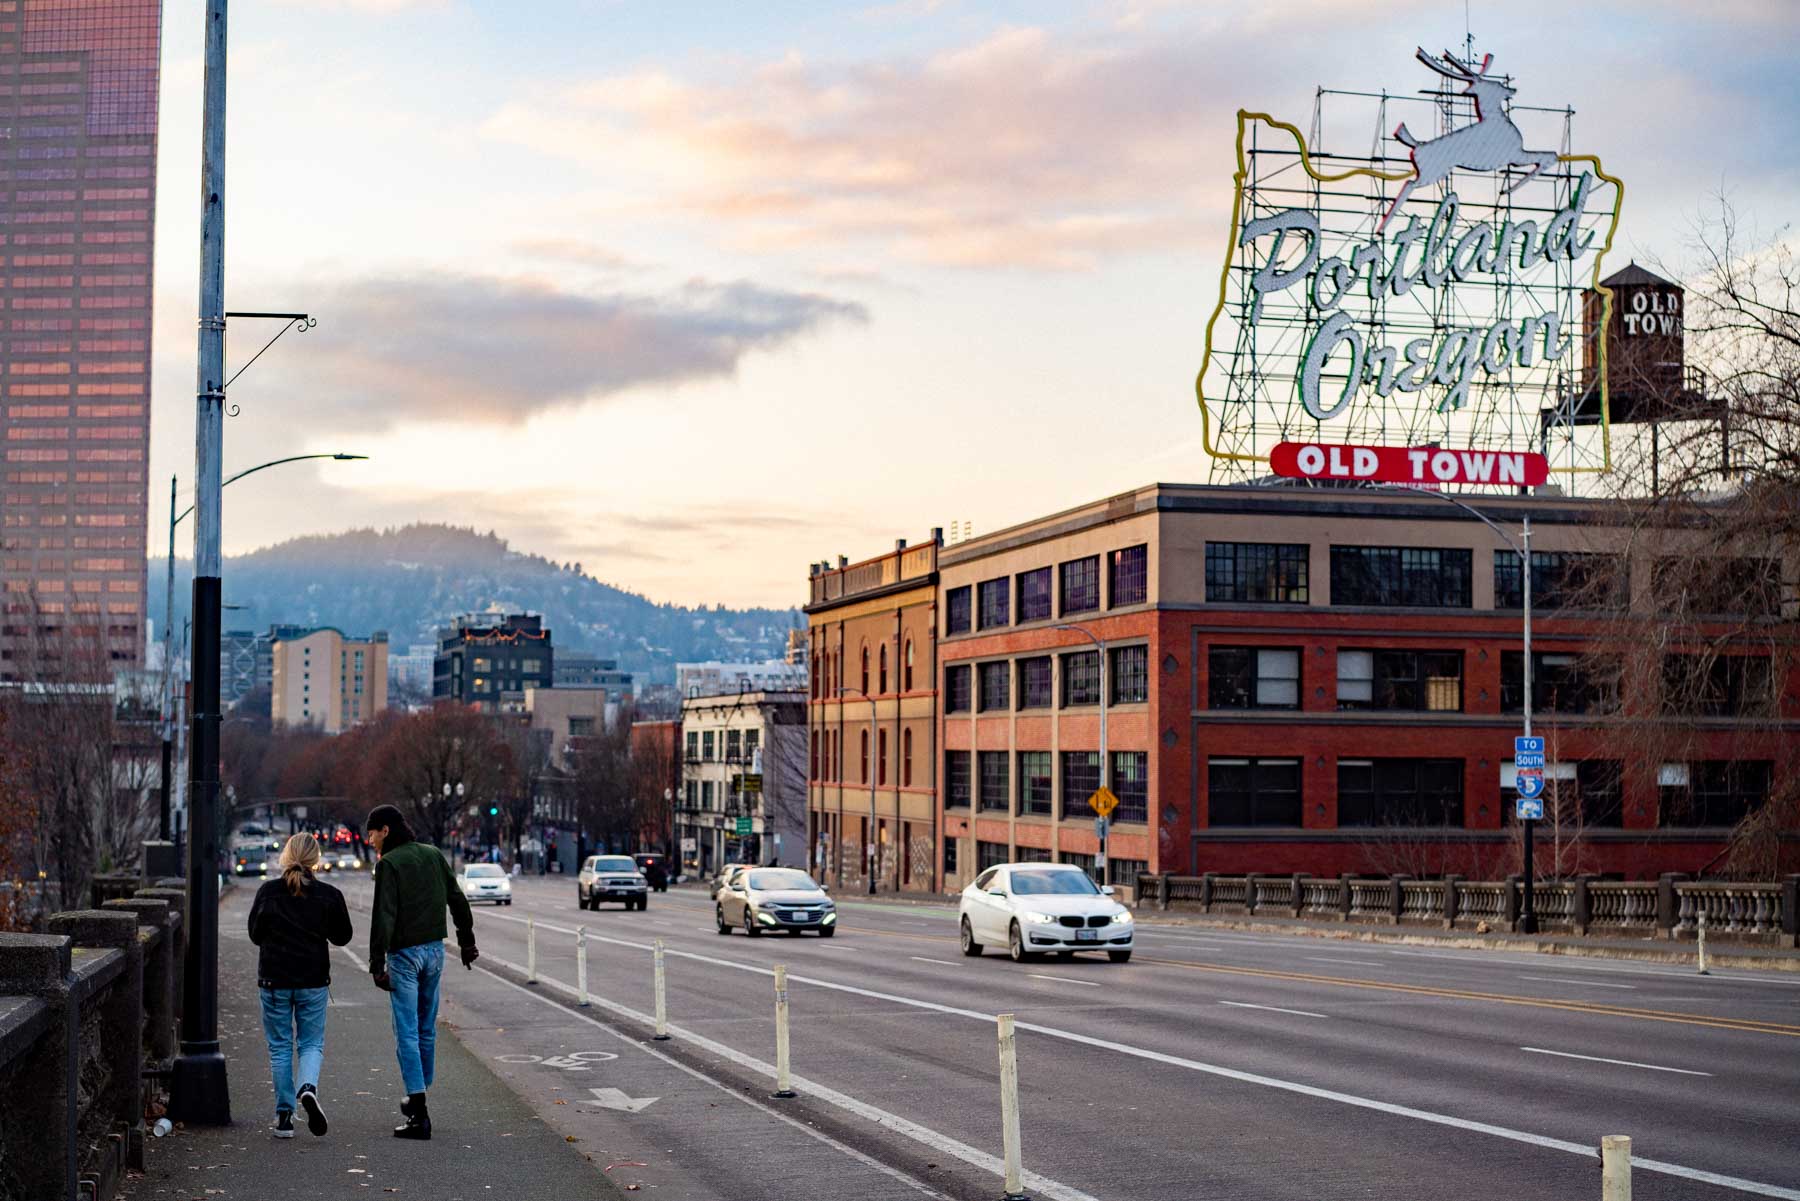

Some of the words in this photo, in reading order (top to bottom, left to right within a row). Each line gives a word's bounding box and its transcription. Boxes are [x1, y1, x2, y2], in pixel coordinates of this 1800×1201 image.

[1239, 171, 1596, 326] Portland
[1633, 292, 1678, 314] OLD
[1298, 311, 1570, 420] Oregon
[1297, 445, 1379, 477] OLD
[1408, 451, 1525, 483] TOWN
[1523, 740, 1537, 749] TO
[1517, 756, 1543, 766] SOUTH
[1526, 777, 1536, 793] 5
